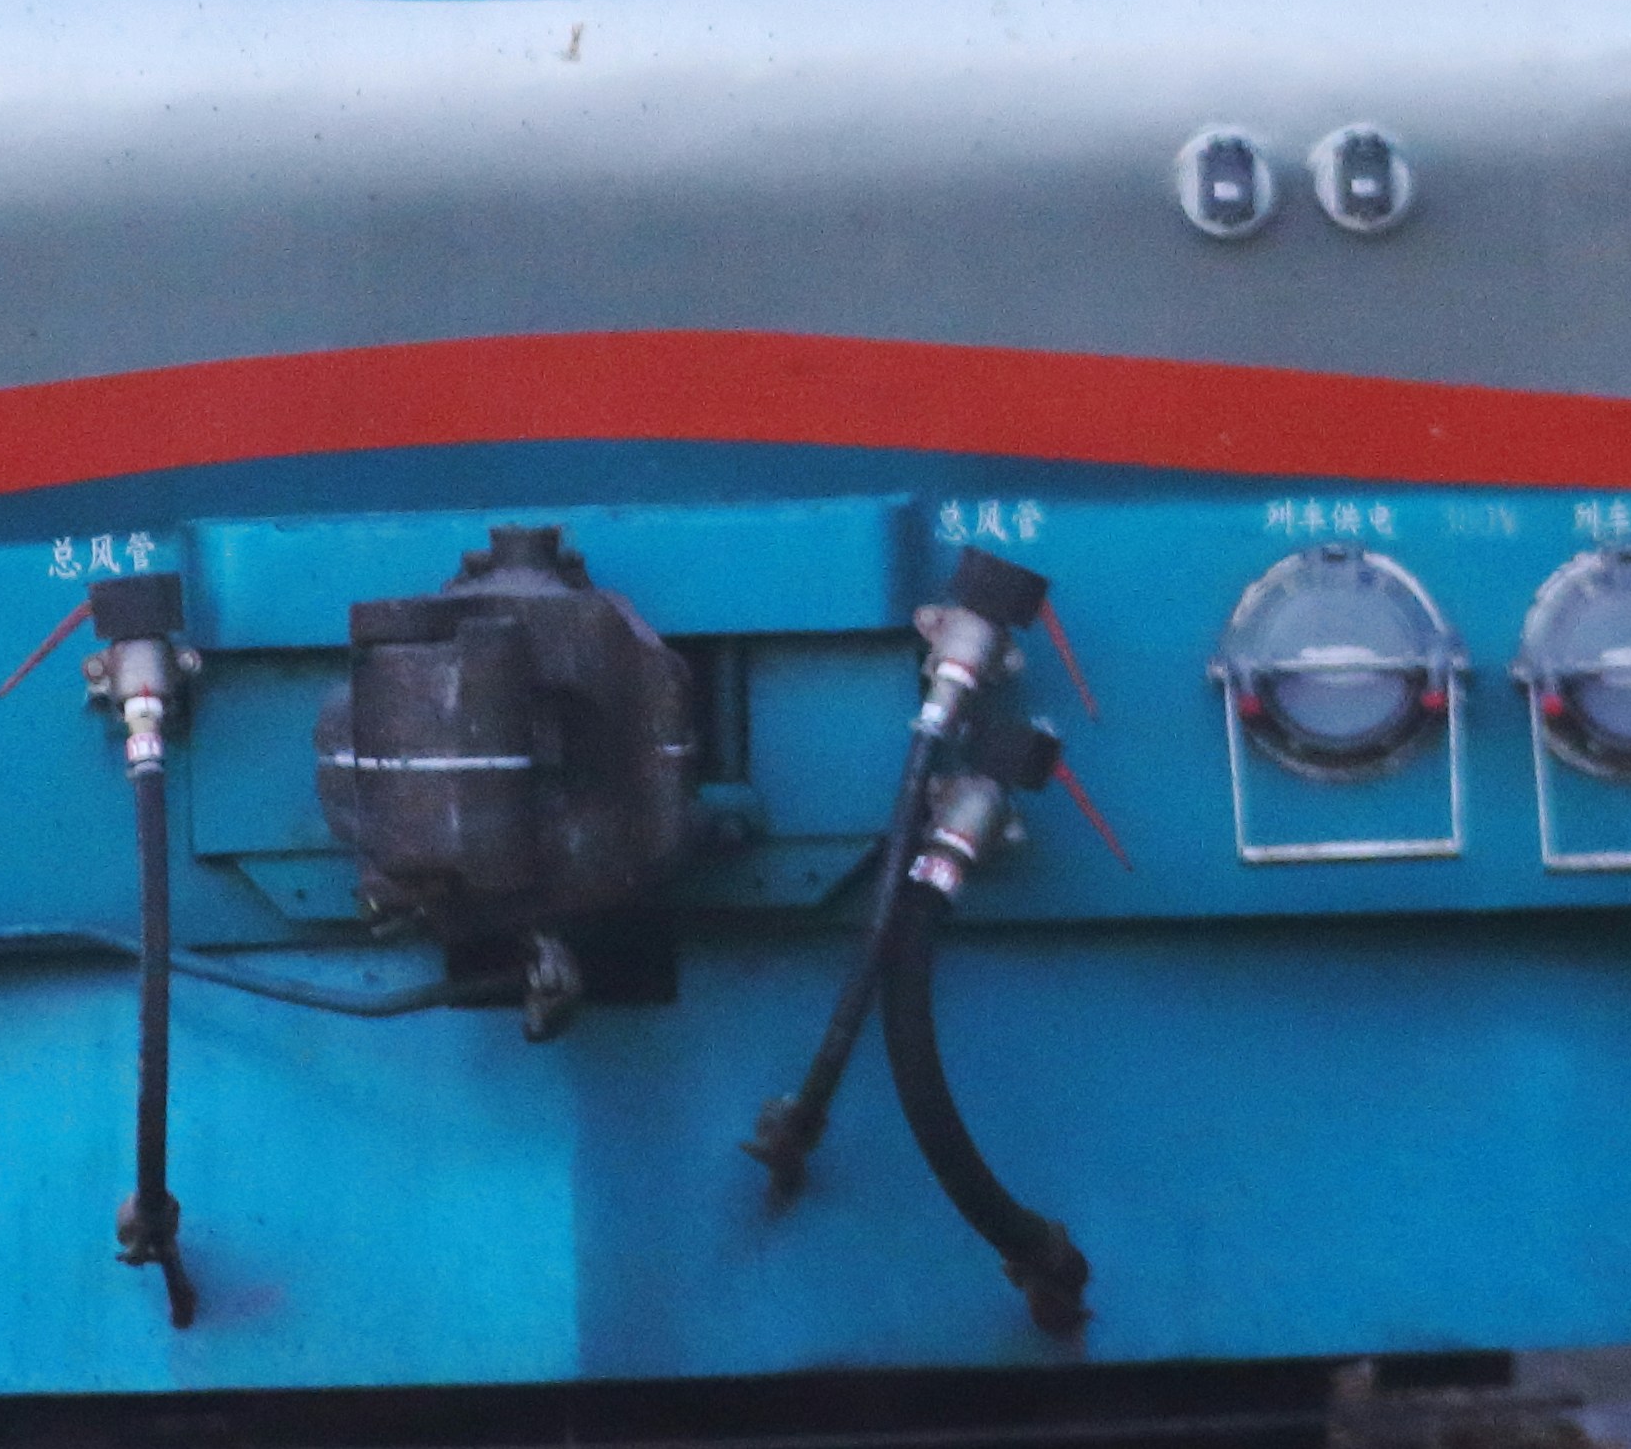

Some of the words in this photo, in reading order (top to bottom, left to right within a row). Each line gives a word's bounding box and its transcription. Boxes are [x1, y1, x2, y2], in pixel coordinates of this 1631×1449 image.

[934, 499, 1044, 541] 总风管
[1265, 497, 1394, 537] 列车供电
[48, 531, 156, 579] 总风管
